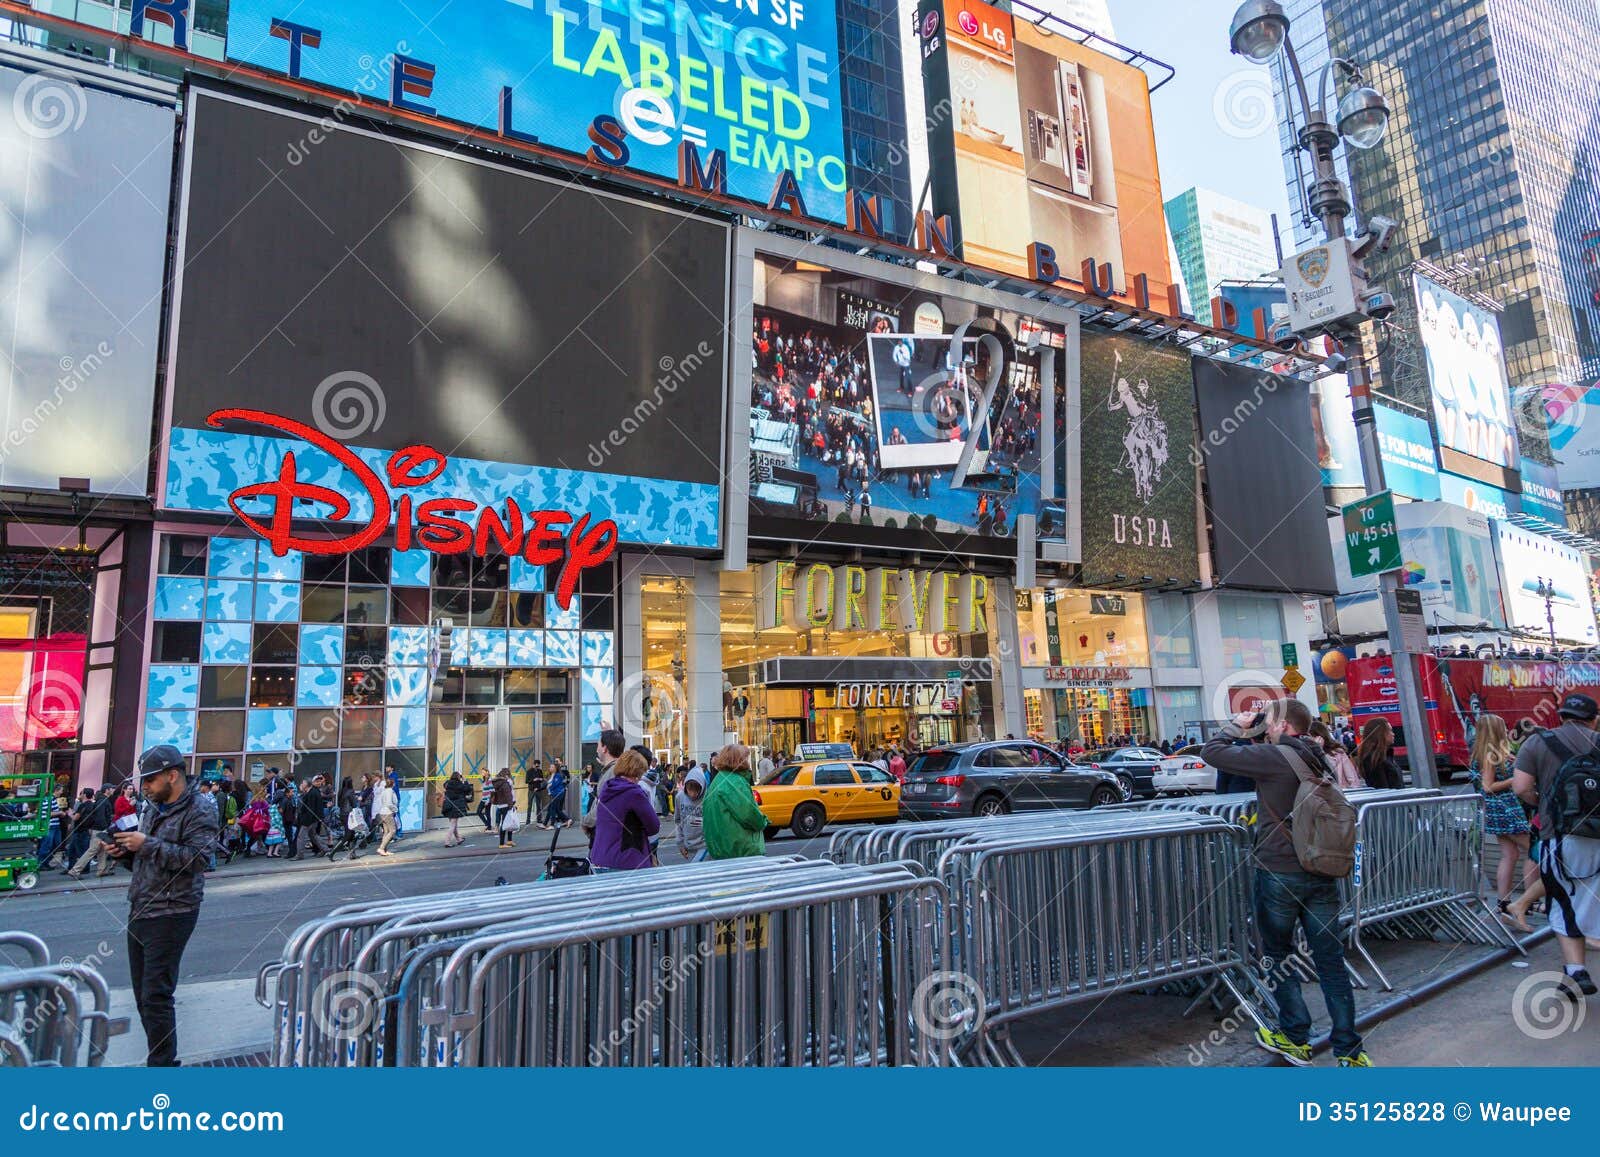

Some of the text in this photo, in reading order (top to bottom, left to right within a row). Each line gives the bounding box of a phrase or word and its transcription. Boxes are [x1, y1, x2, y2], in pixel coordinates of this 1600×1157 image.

[923, 37, 940, 59] LG
[982, 22, 1007, 48] LG
[552, 11, 811, 142] LABELED
[729, 126, 847, 192] EMPO
[1304, 285, 1333, 301] SECURITY
[1360, 507, 1375, 522] To
[1113, 513, 1172, 548] USPA
[1348, 520, 1394, 547] W 45 St
[770, 559, 988, 632] FOREVER
[834, 682, 923, 709] FOREVER
[1354, 842, 1362, 884] NYPD
